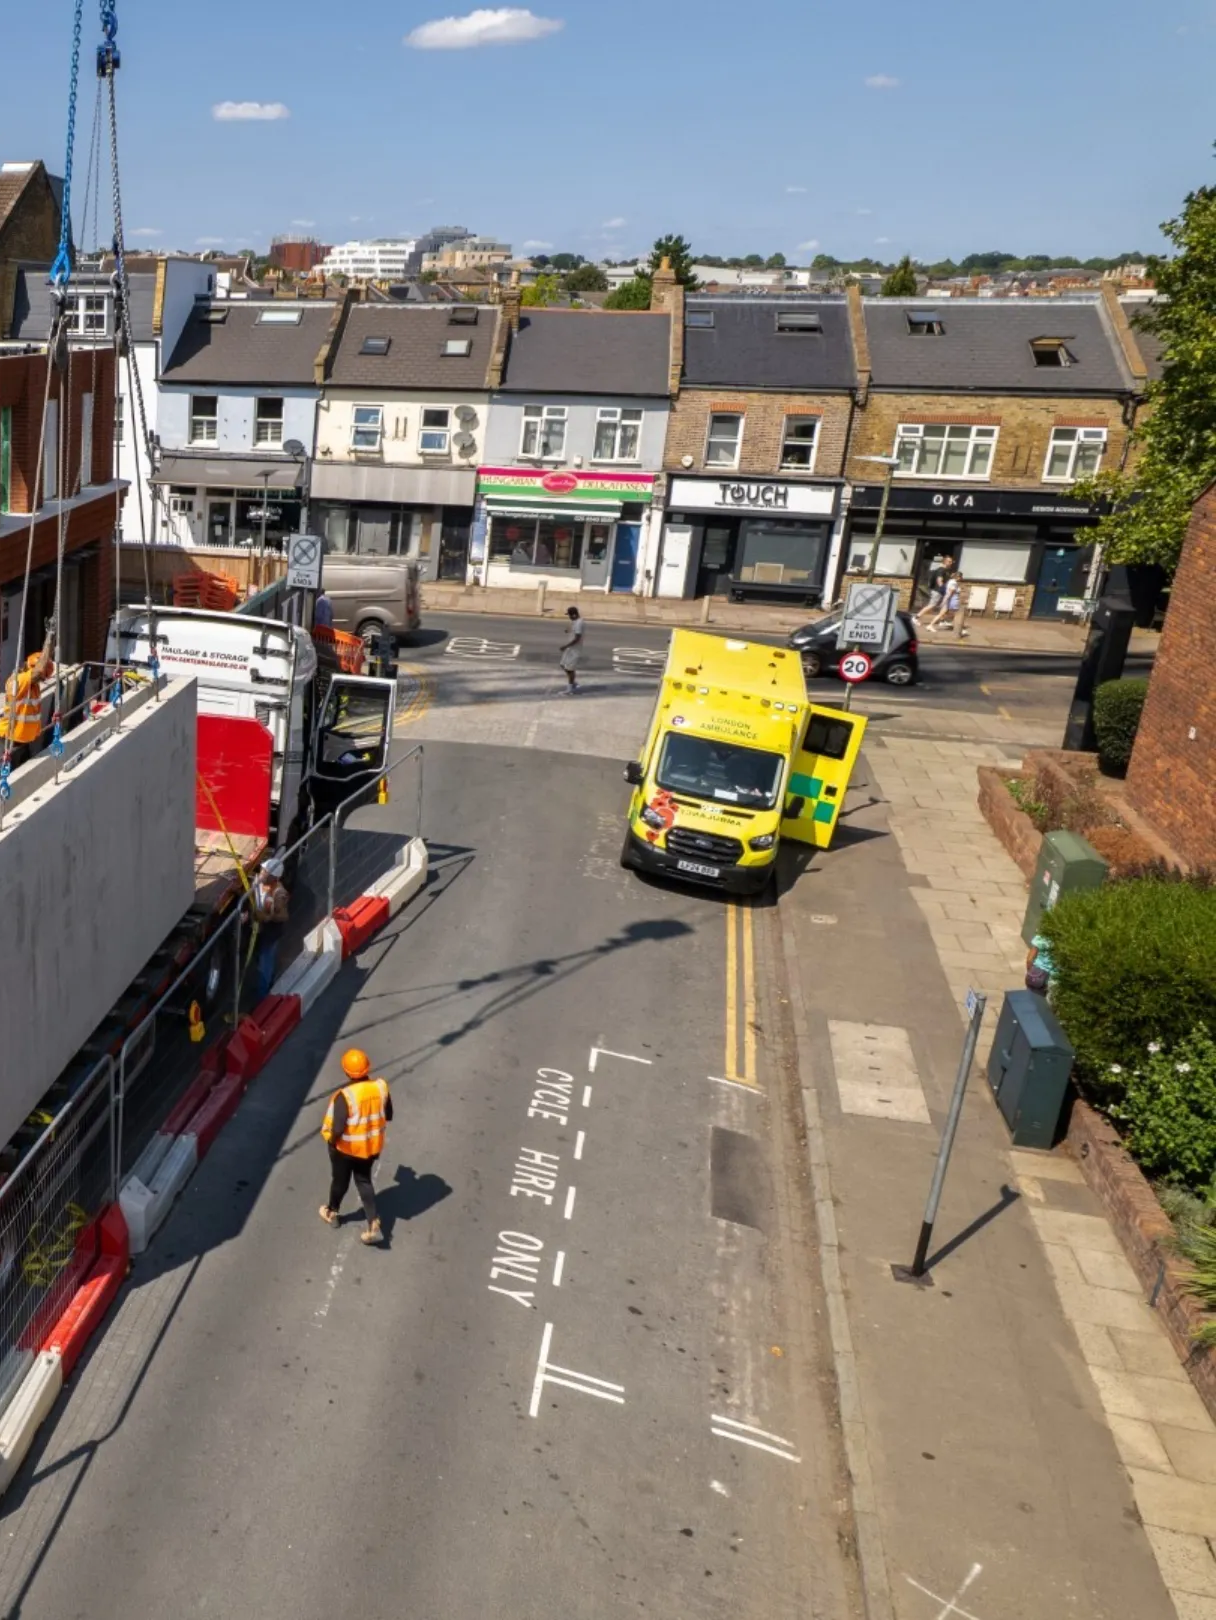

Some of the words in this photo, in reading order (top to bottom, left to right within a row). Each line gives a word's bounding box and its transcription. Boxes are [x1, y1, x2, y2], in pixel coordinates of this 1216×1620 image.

[481, 475, 537, 486] HUNGARIAN
[582, 480, 648, 492] DELICATESSEN
[719, 483, 788, 505] TOUCH
[932, 494, 974, 507] OKA
[854, 622, 875, 630] Zone
[848, 630, 877, 640] ENDS
[161, 646, 201, 657] HAULAGE
[201, 650, 208, 658] &
[209, 652, 249, 662] STORAGE
[844, 661, 867, 673] 20
[711, 716, 751, 730] LONDON
[700, 723, 758, 740] AMBULANCE
[527, 1067, 574, 1126] CYCLE
[510, 1147, 560, 1206] HIRE
[488, 1230, 544, 1308] ONLY
